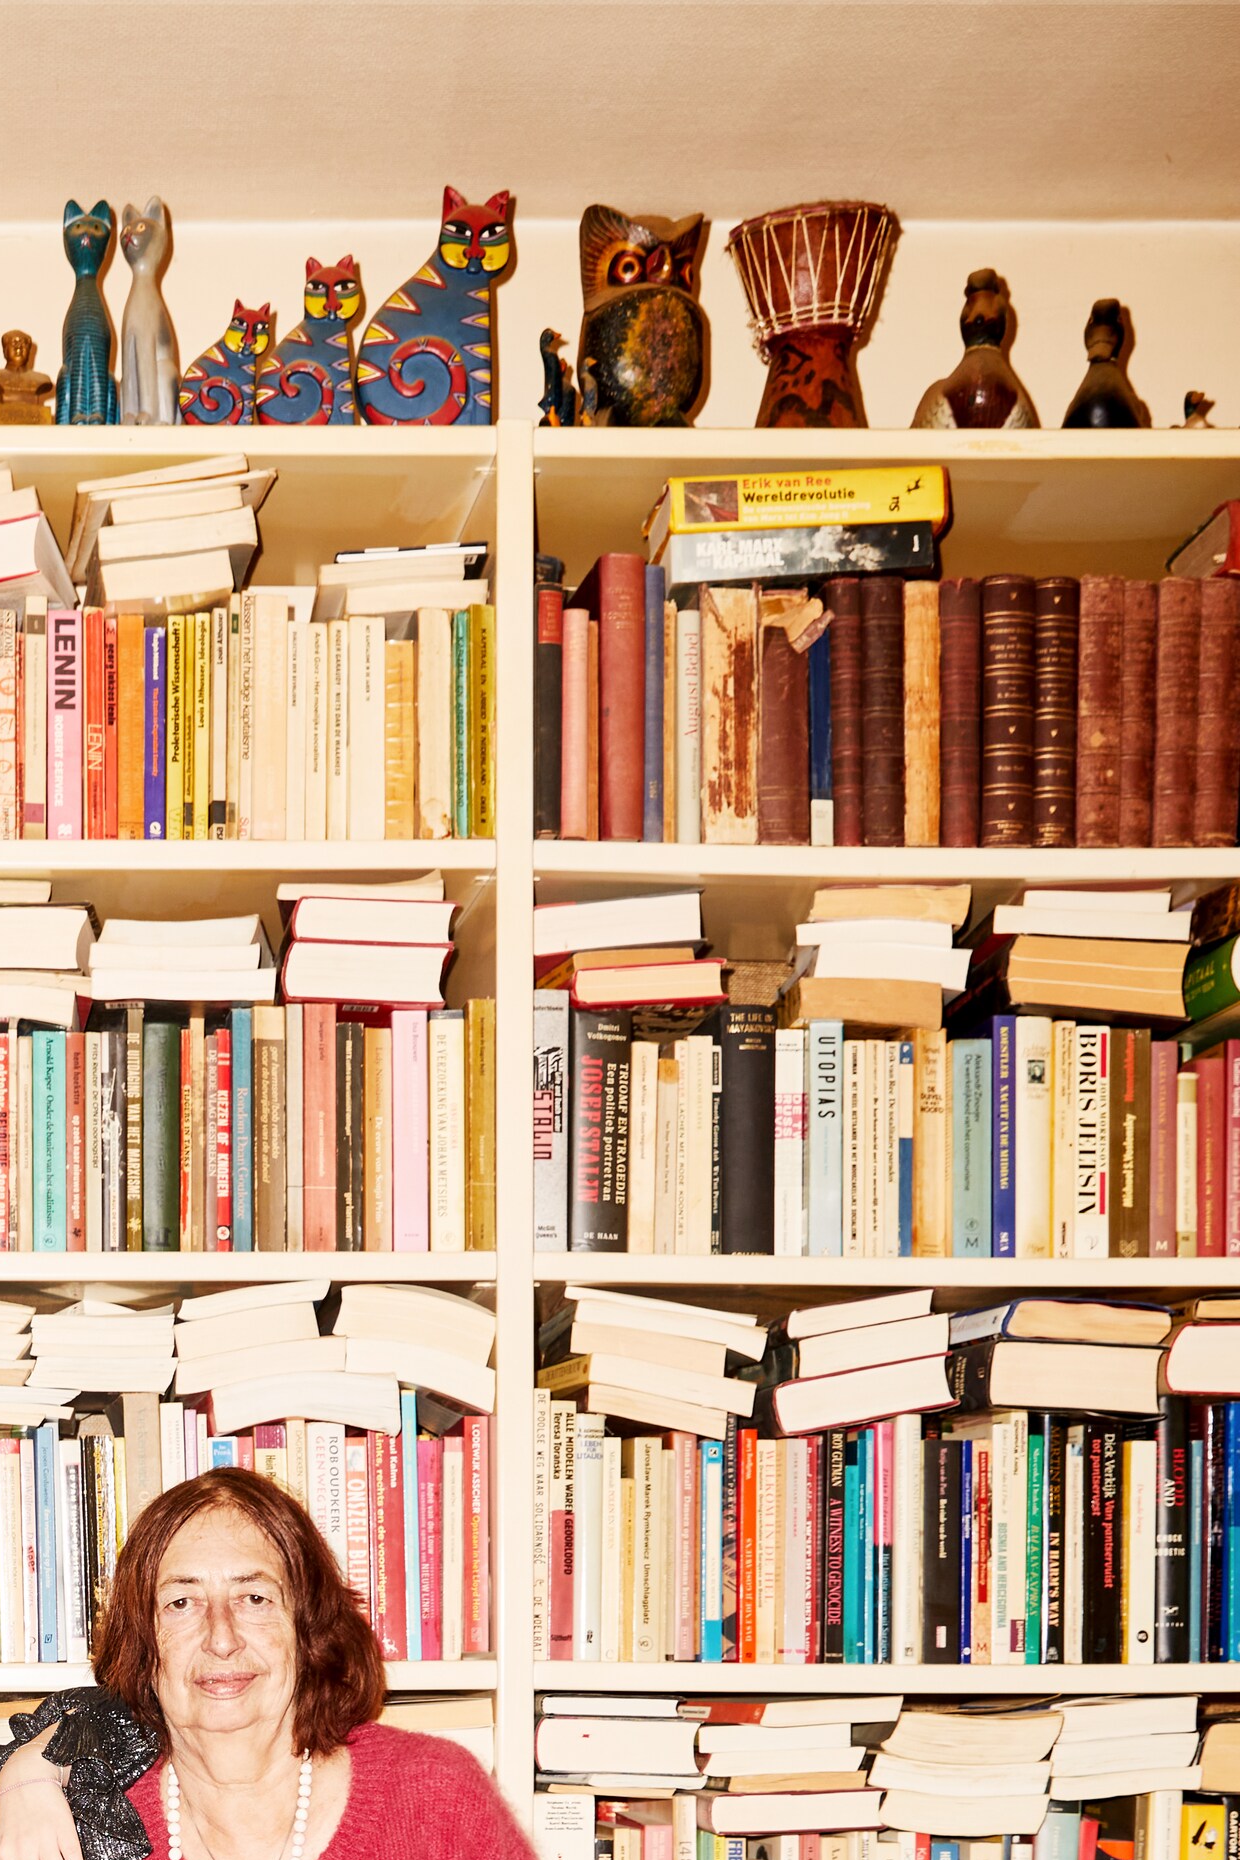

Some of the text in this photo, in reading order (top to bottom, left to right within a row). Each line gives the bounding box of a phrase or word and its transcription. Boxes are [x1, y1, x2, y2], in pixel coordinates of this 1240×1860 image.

[743, 477, 832, 489] Erik van Ree
[743, 489, 855, 503] Wereldrevolutie
[54, 618, 76, 710] LENIN
[54, 715, 64, 807] ROBERT SERVICE
[818, 1036, 835, 1119] UTOPIAS
[1099, 1082, 1107, 1108] JOHN
[217, 1090, 228, 1198] KIEZEN OF KNOEIEN
[1078, 1033, 1097, 1215] BORIS JELTSIN
[552, 1412, 563, 1439] Teresa
[329, 1436, 340, 1534] ROB OUDKERK
[830, 1433, 844, 1487] ROY GUTMAN
[828, 1508, 842, 1553] WITNESS
[828, 1554, 842, 1569] TO
[827, 1571, 842, 1626] GENOCIDE
